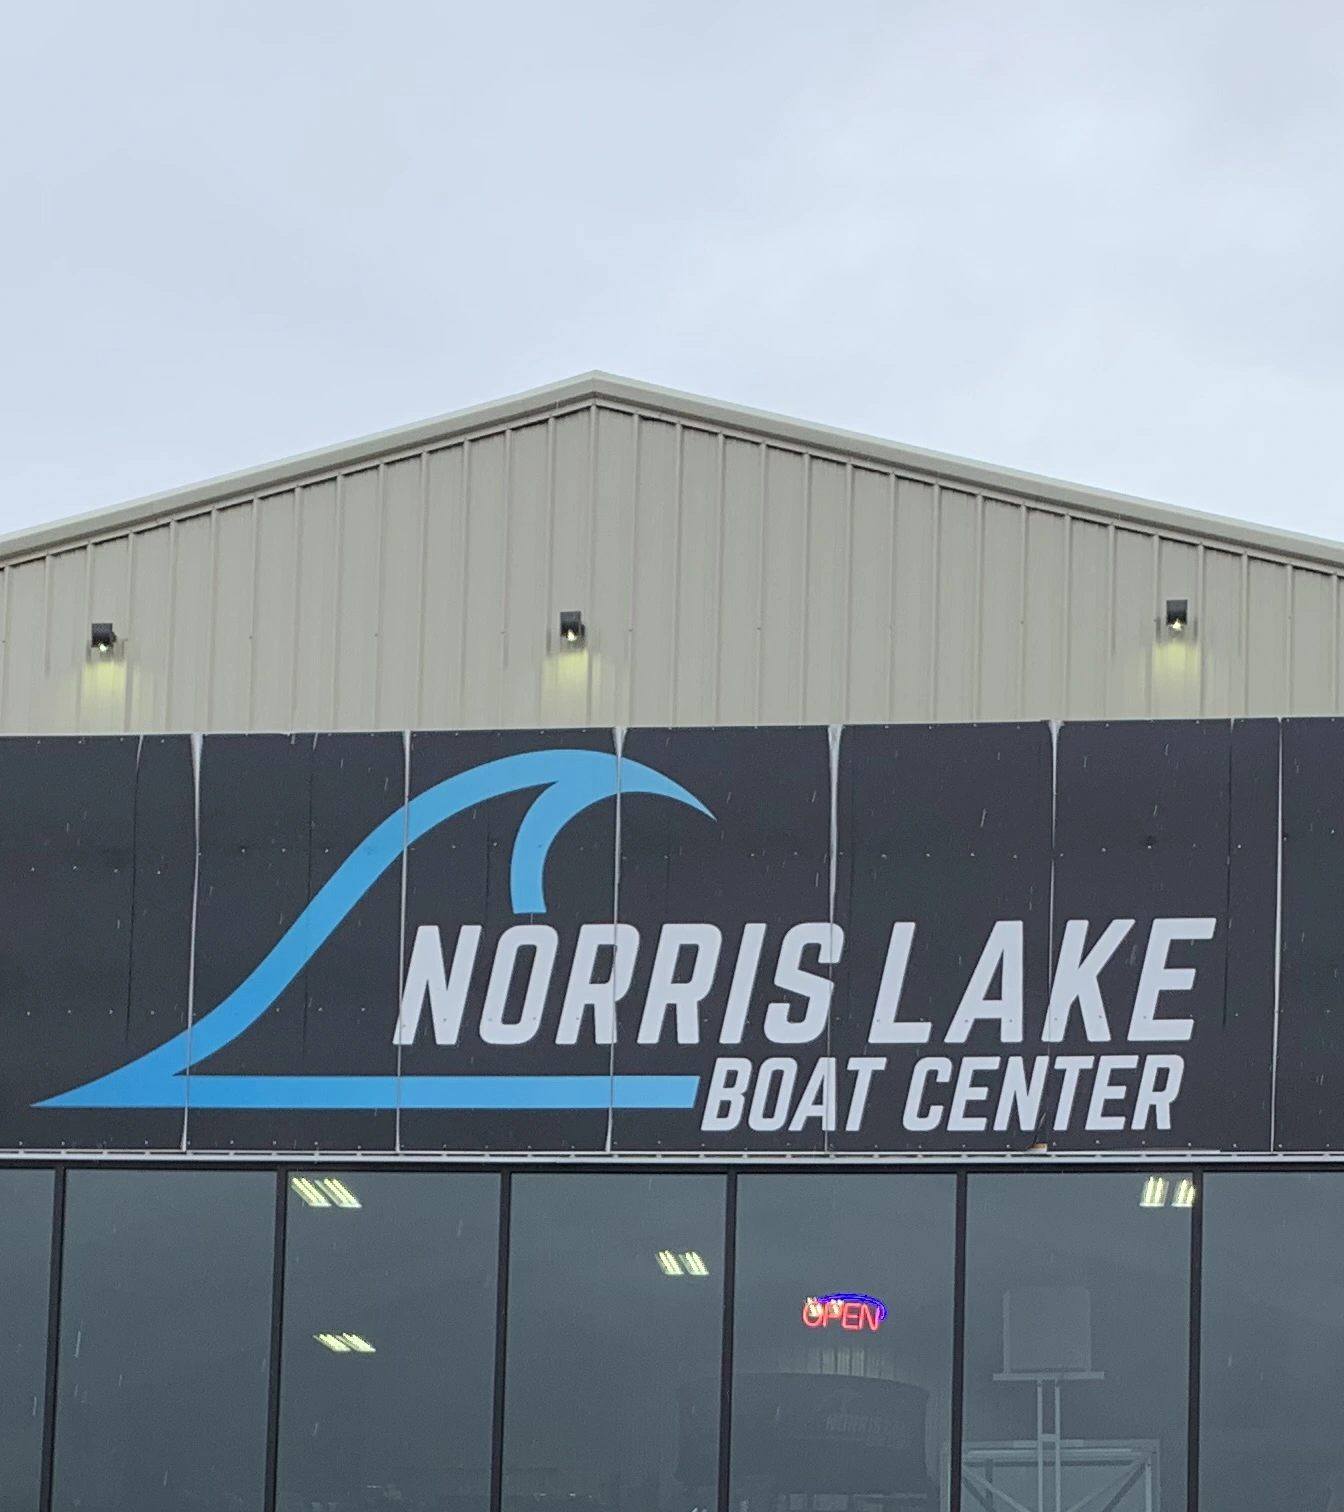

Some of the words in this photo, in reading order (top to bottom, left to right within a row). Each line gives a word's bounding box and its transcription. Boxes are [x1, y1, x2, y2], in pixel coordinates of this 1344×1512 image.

[392, 920, 844, 1046] NORRIS
[867, 917, 1218, 1044] LAKE
[700, 1056, 889, 1133] BOAT
[901, 1053, 1186, 1132] CENTER
[802, 1298, 881, 1331] OPEN
